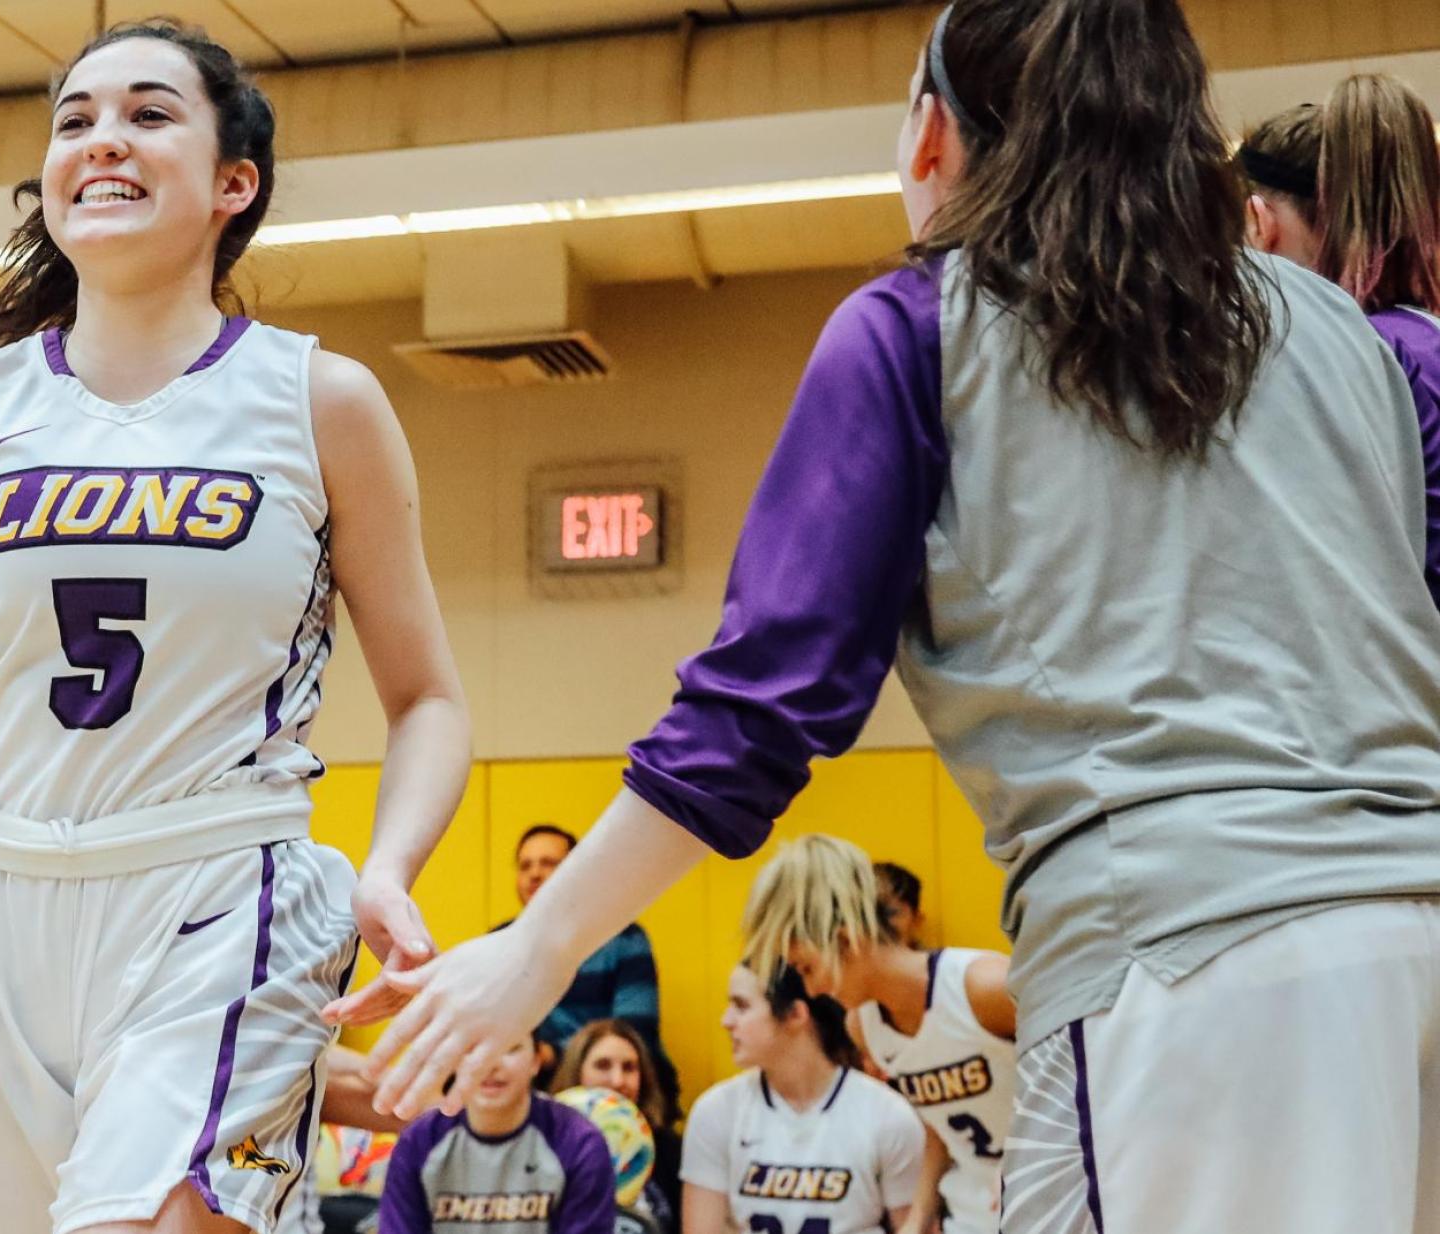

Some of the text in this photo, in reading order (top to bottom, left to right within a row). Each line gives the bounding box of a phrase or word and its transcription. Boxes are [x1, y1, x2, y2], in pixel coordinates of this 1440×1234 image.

[562, 494, 644, 559] EXIT
[49, 577, 147, 730] 5
[896, 1057, 990, 1104] LIONS
[742, 1164, 850, 1200] LIONS
